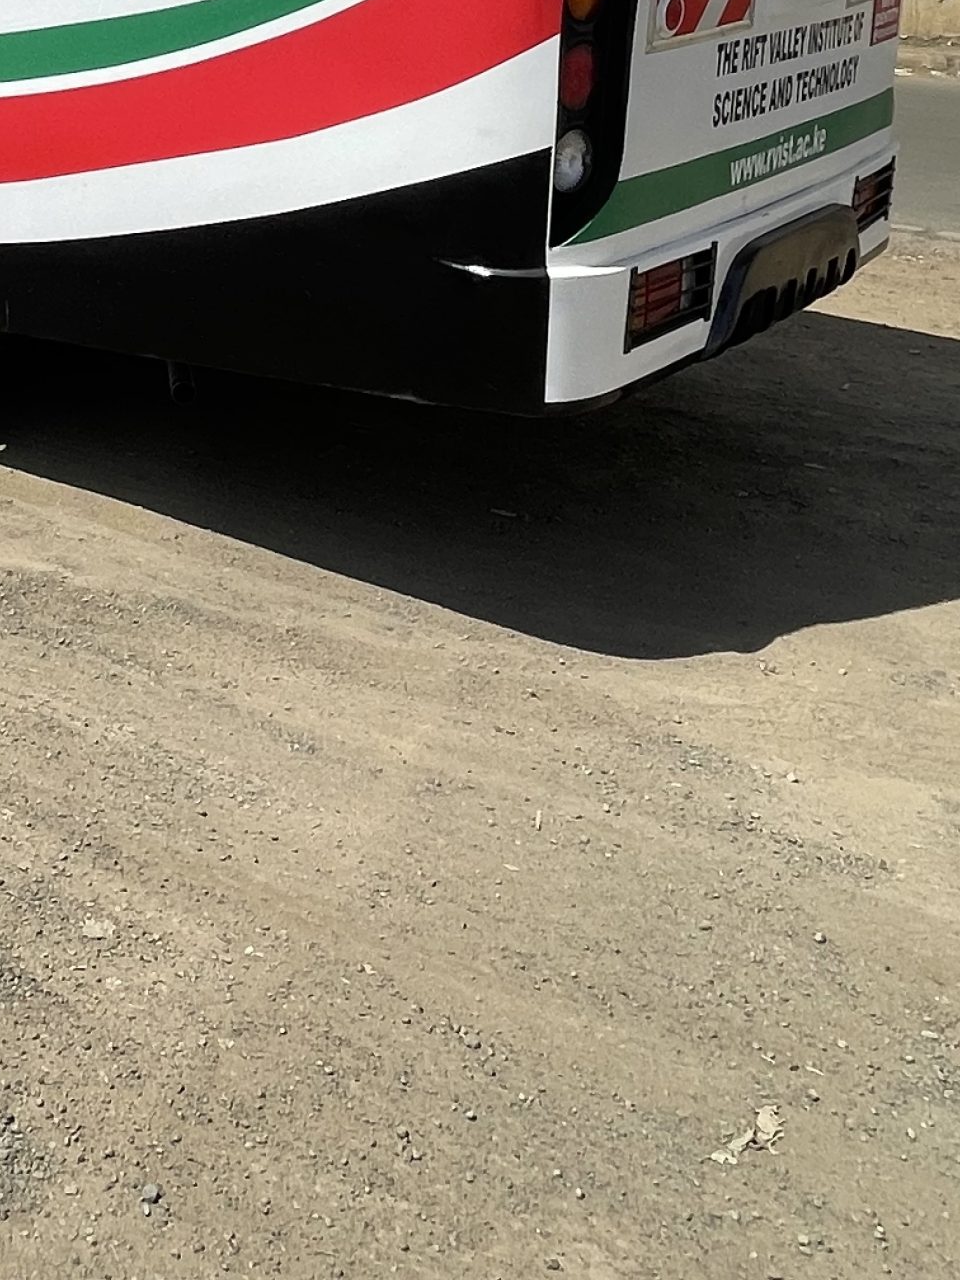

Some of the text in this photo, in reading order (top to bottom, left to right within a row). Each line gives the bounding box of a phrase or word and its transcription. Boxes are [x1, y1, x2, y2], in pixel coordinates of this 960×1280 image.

[716, 40, 740, 78] THE
[741, 34, 768, 72] RIFT
[768, 25, 808, 65] VALLEY
[807, 15, 854, 55] INSTITUTE
[853, 11, 865, 42] OF
[712, 55, 860, 128] SCIENCE AND TECHNOLOGY
[730, 123, 827, 186] www.rvist.ac.ke
